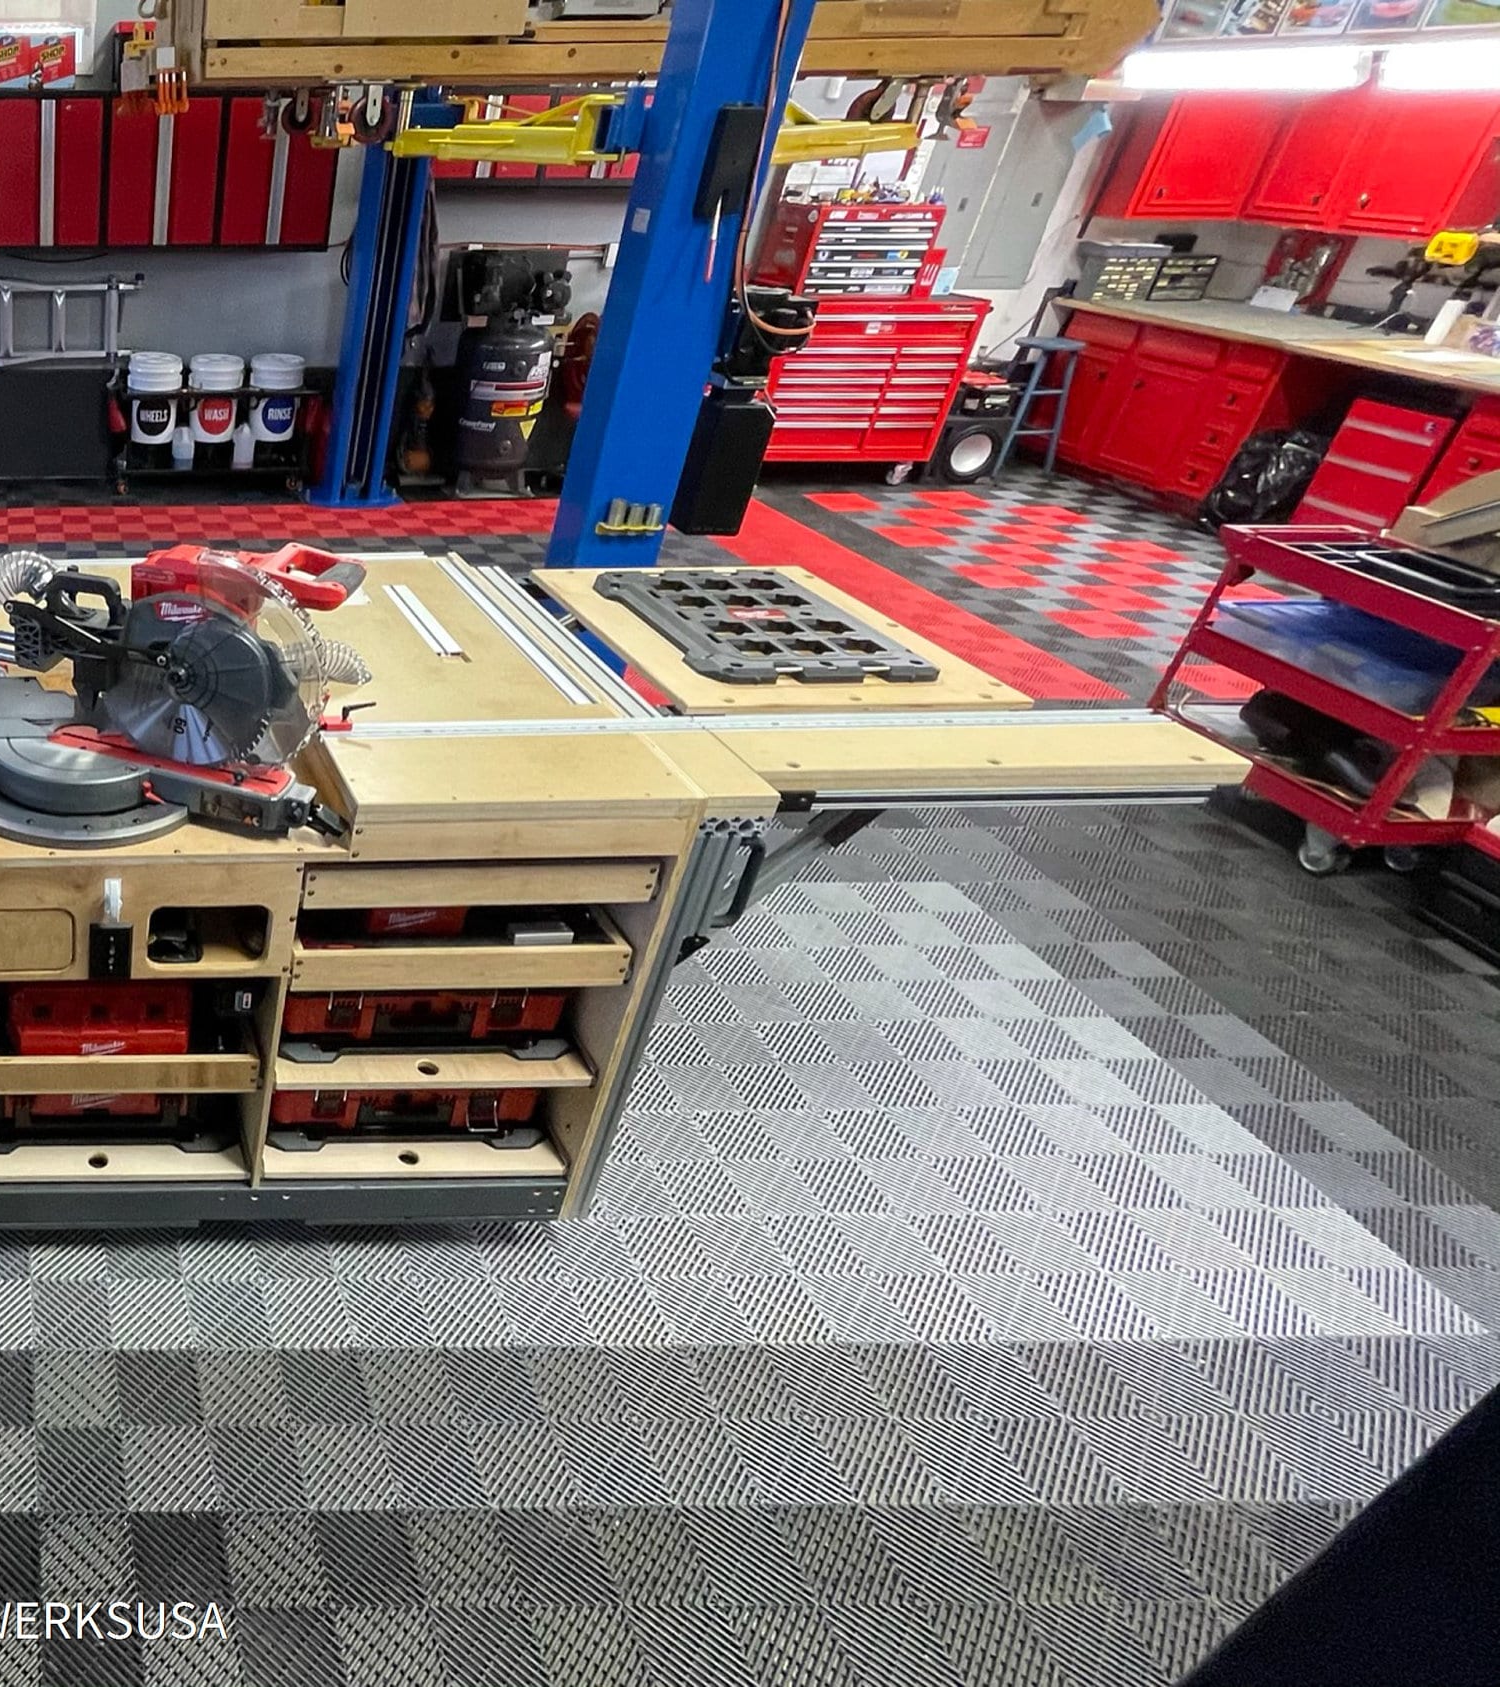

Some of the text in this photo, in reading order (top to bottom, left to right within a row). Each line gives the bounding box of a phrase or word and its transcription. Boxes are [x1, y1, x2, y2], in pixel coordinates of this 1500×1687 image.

[41, 46, 65, 60] SHOP
[139, 409, 168, 422] WHEELS
[203, 407, 230, 421] WASH
[267, 407, 293, 421] RINSE
